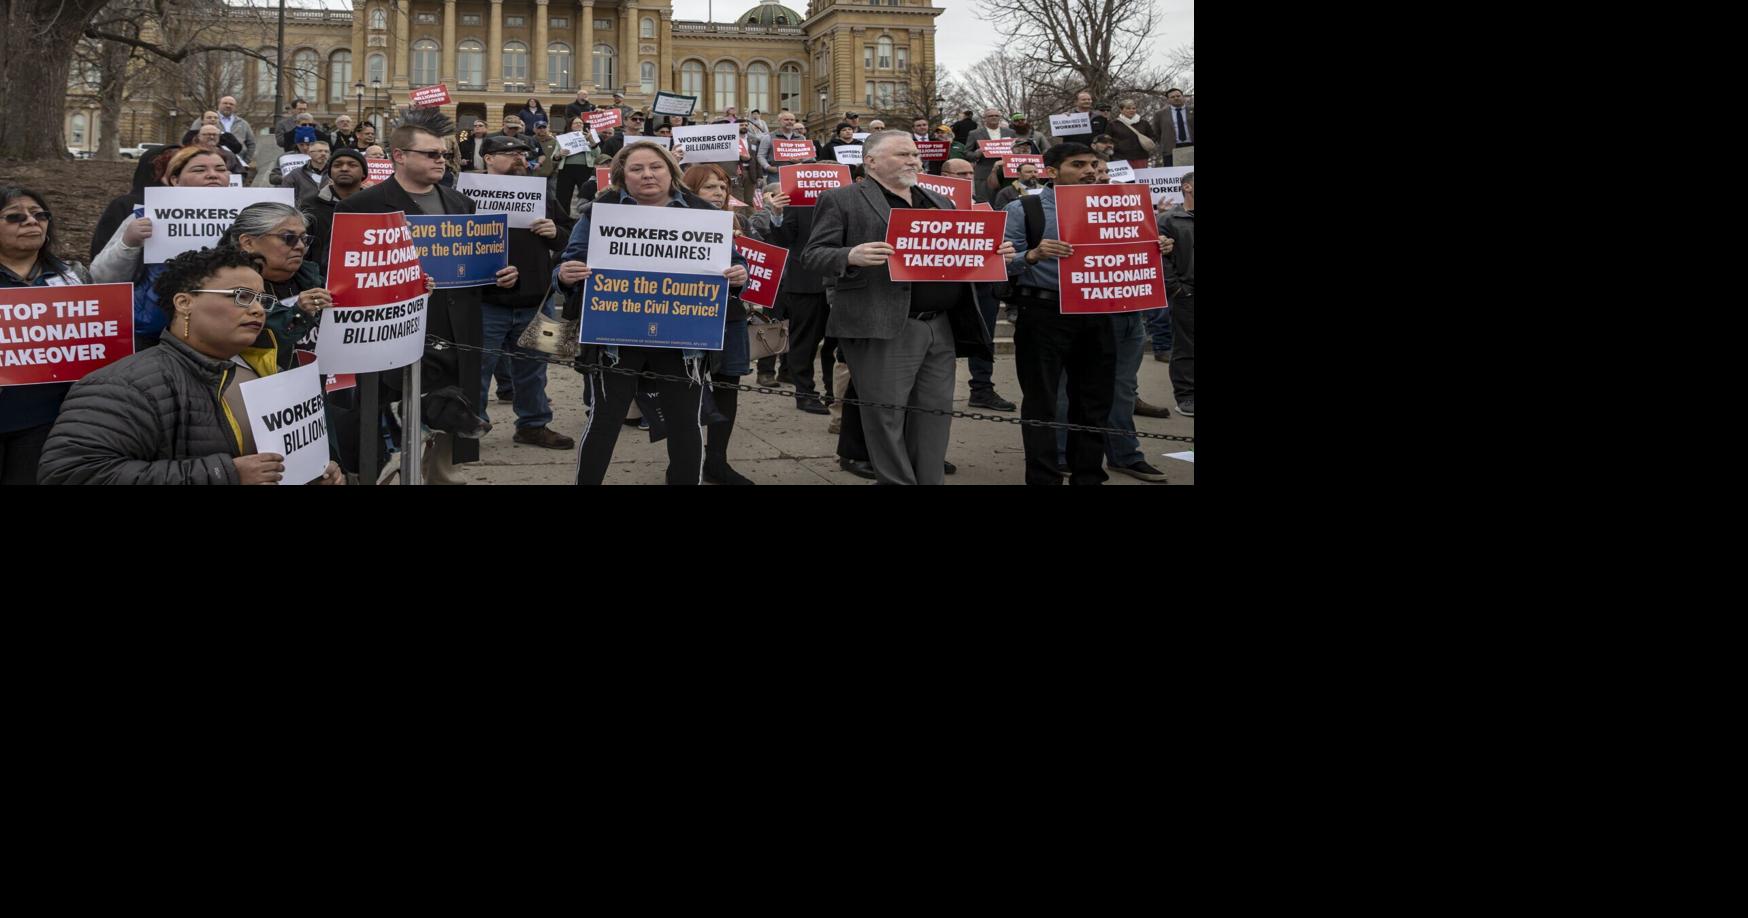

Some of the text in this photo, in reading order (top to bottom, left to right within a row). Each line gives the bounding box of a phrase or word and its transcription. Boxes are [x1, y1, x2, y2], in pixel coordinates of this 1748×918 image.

[678, 135, 716, 143] WORKERS
[686, 142, 731, 152] BILLIONAIRES!
[796, 170, 838, 178] NOBODY
[797, 180, 841, 188] ELECTED
[463, 188, 542, 200] WORKERS OVER
[1086, 195, 1141, 208] NOBODY
[155, 208, 239, 219] WORKERS
[1087, 210, 1144, 223] ELECTED
[406, 219, 504, 239] ave the Country
[599, 225, 724, 244] WORKERS OVER
[910, 221, 985, 234] STOP THE
[1100, 226, 1139, 239] MUSK
[363, 227, 400, 245] STOP
[896, 237, 994, 251] BILLIONAIRE
[432, 243, 449, 256] the
[452, 242, 473, 256] Civil
[475, 240, 505, 255] Service!
[609, 241, 711, 261] BILLIONAIRES!
[741, 246, 767, 263] THE
[903, 254, 985, 267] TAKEOVER
[1084, 253, 1148, 267] STOP THE
[355, 264, 420, 289] TAKEOVER
[1071, 268, 1156, 284] BILLIONAIRE
[594, 273, 720, 301] Save the Country
[1081, 284, 1152, 299] TAKEOVER
[0, 300, 99, 320] TOP THE
[333, 298, 424, 324] WORKERS OVER
[591, 297, 719, 317] Save the Civil Service!
[343, 316, 420, 345] BILLIONAIRES!
[261, 394, 324, 432] WORKER
[283, 416, 327, 456] BILLION
